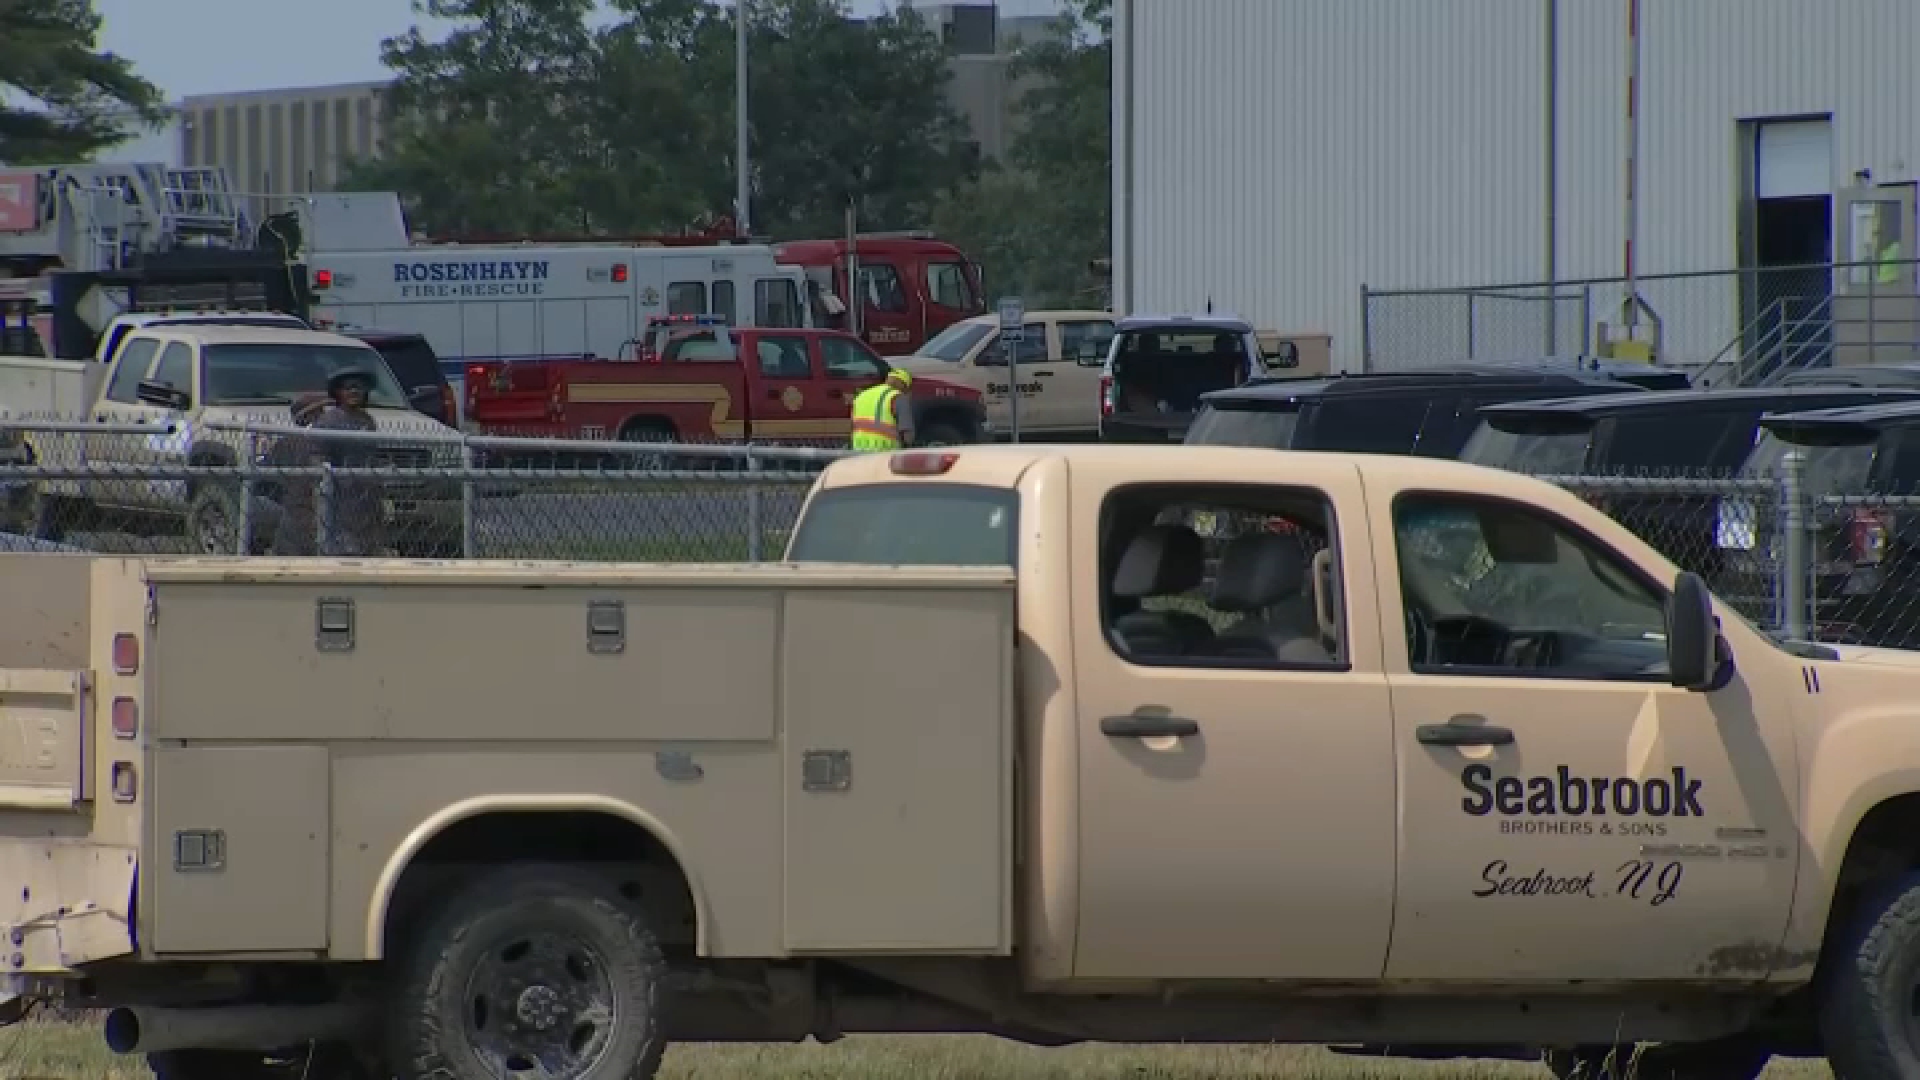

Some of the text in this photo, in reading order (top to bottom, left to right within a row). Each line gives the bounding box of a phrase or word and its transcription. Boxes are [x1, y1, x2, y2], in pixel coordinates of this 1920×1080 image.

[393, 261, 549, 282] ROSENHAYN
[987, 381, 1043, 394] Searook
[1461, 763, 1704, 816] Seabrook
[1499, 820, 1668, 836] BROTHERS & SONS
